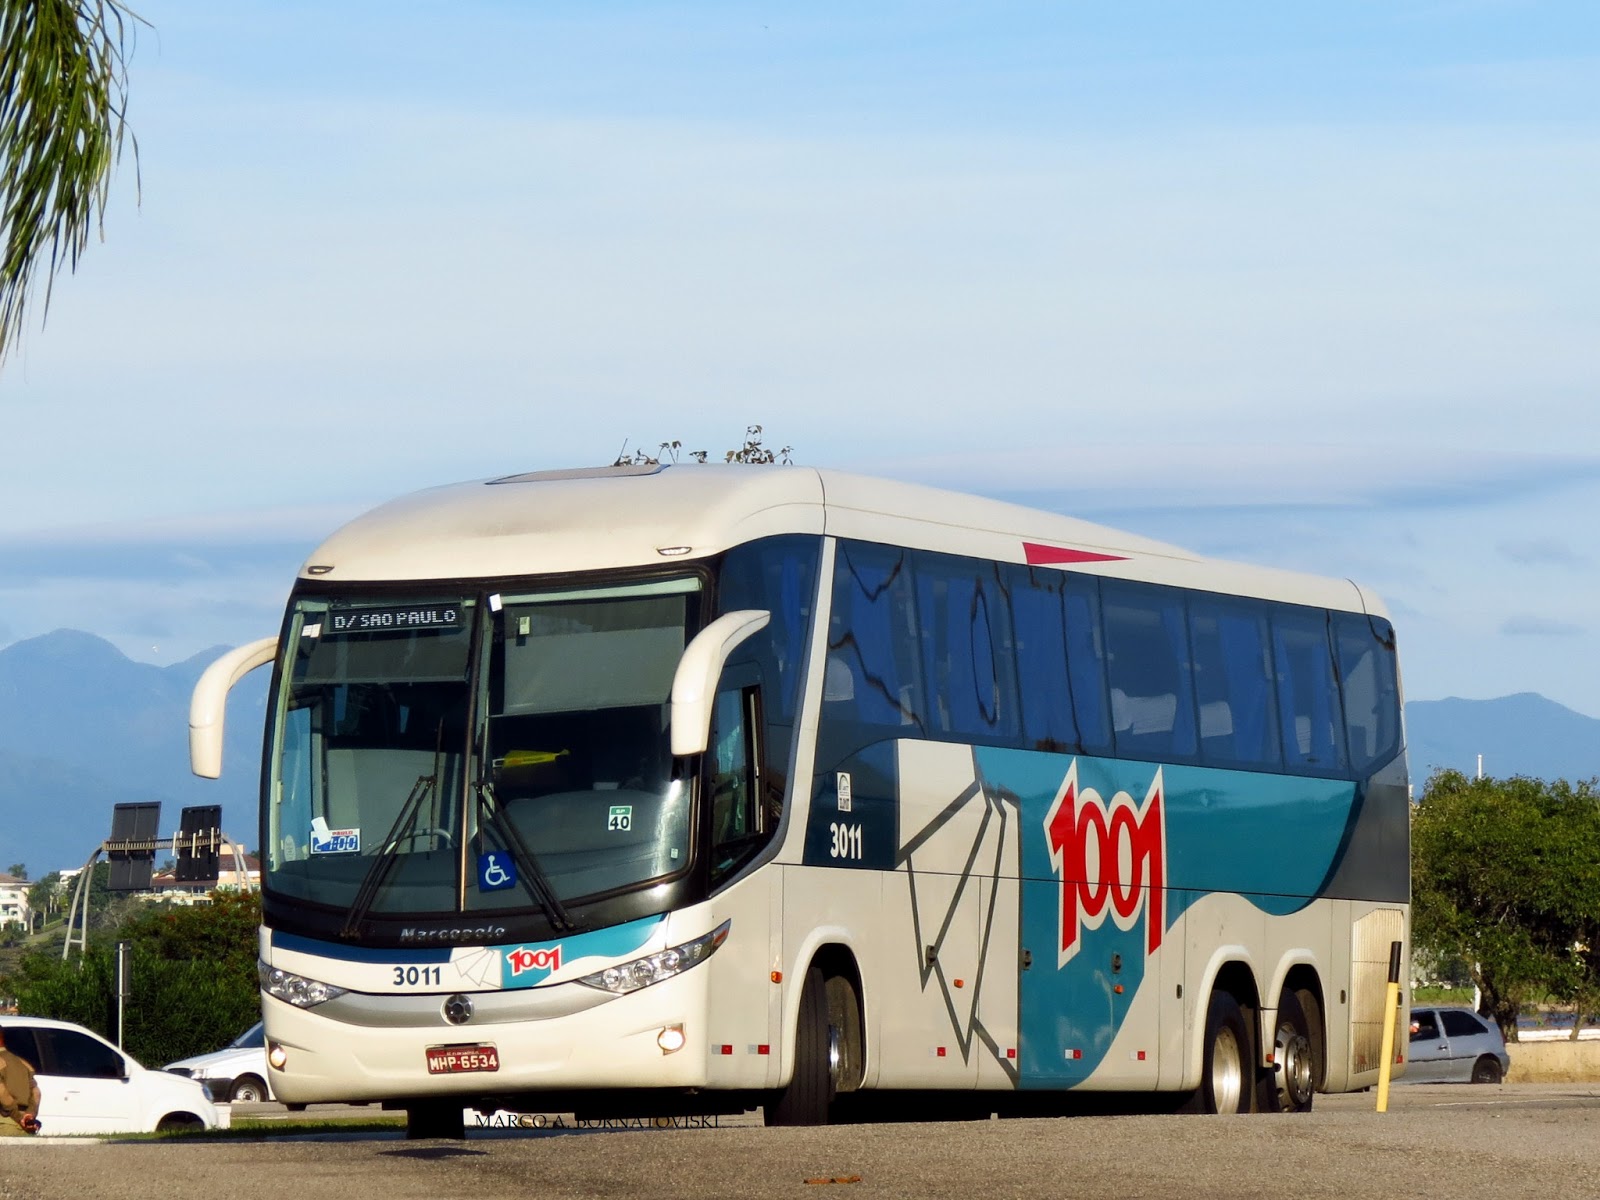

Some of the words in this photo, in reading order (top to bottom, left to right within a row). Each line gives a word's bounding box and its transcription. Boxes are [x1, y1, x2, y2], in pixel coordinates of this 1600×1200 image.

[334, 614, 357, 629] D/
[360, 612, 393, 627] SAO
[396, 609, 456, 625] PAULO
[609, 815, 630, 830] 40
[829, 822, 862, 860] 3011
[1045, 766, 1165, 963] 1001
[399, 925, 506, 943] Marcopolo
[507, 944, 562, 975] 1001
[392, 965, 441, 986] 3011
